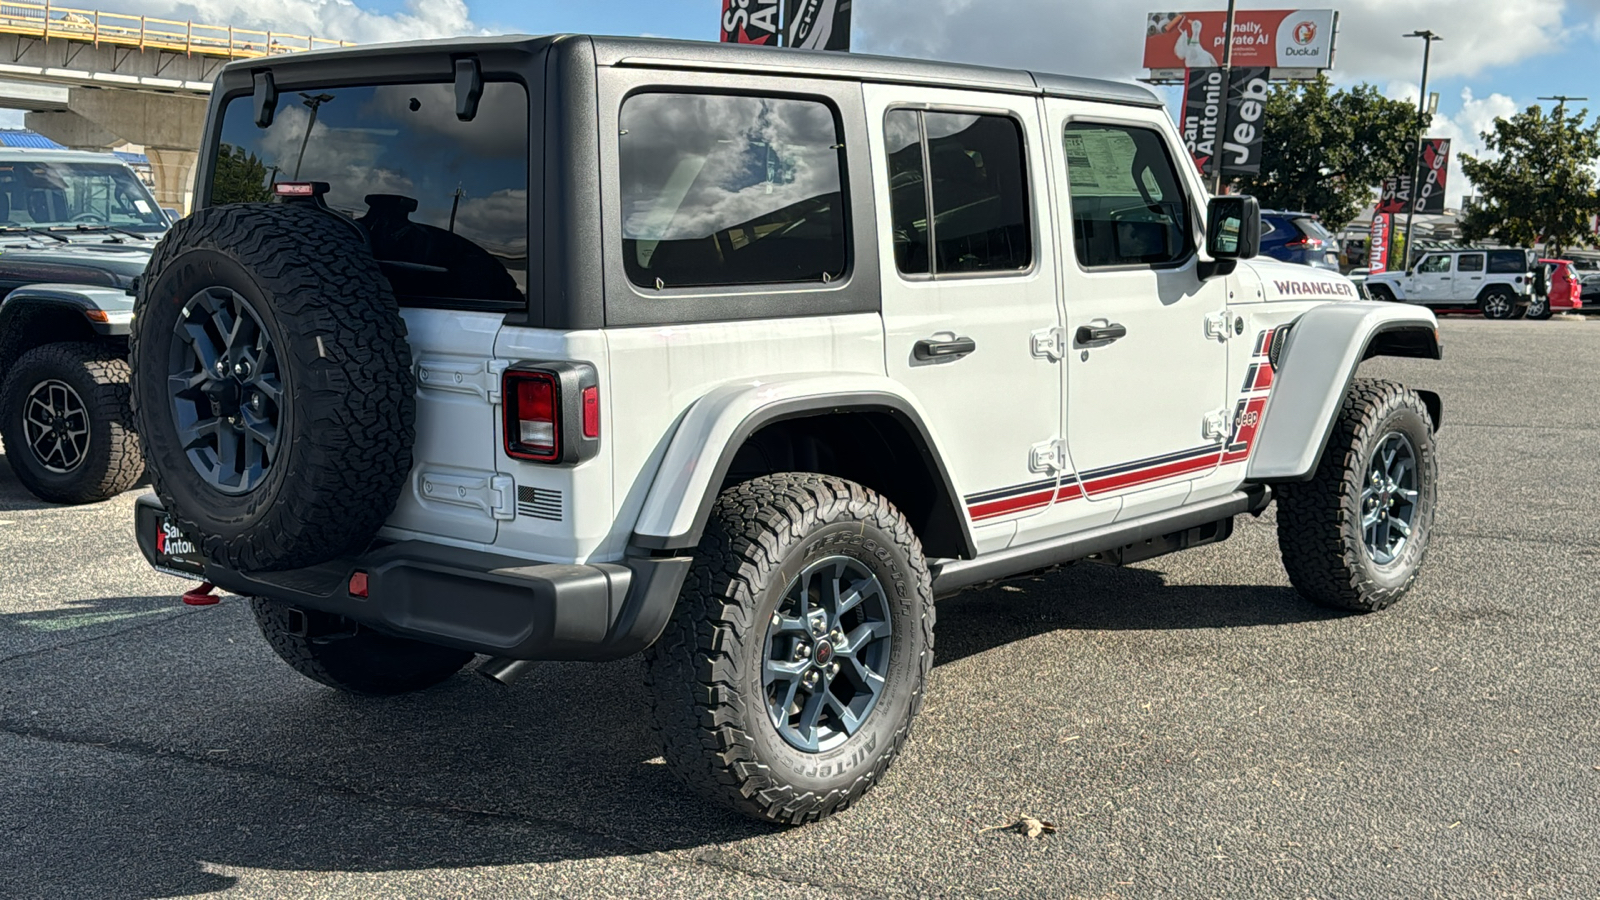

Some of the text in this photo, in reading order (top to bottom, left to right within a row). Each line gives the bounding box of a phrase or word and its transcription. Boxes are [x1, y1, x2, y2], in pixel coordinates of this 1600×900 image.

[750, 0, 777, 33] A
[799, 0, 818, 39] CH
[1222, 21, 1262, 34] Fnally,
[1213, 34, 1269, 47] prvate AI
[1285, 46, 1320, 56] Duck.ai
[1197, 72, 1222, 155] Antonio
[1222, 77, 1268, 164] Jeep
[1184, 116, 1199, 153] San
[1415, 141, 1449, 212] DODGE
[1273, 280, 1353, 297] WRANGLER
[1235, 409, 1258, 427] Jeep
[163, 538, 196, 555] Anton
